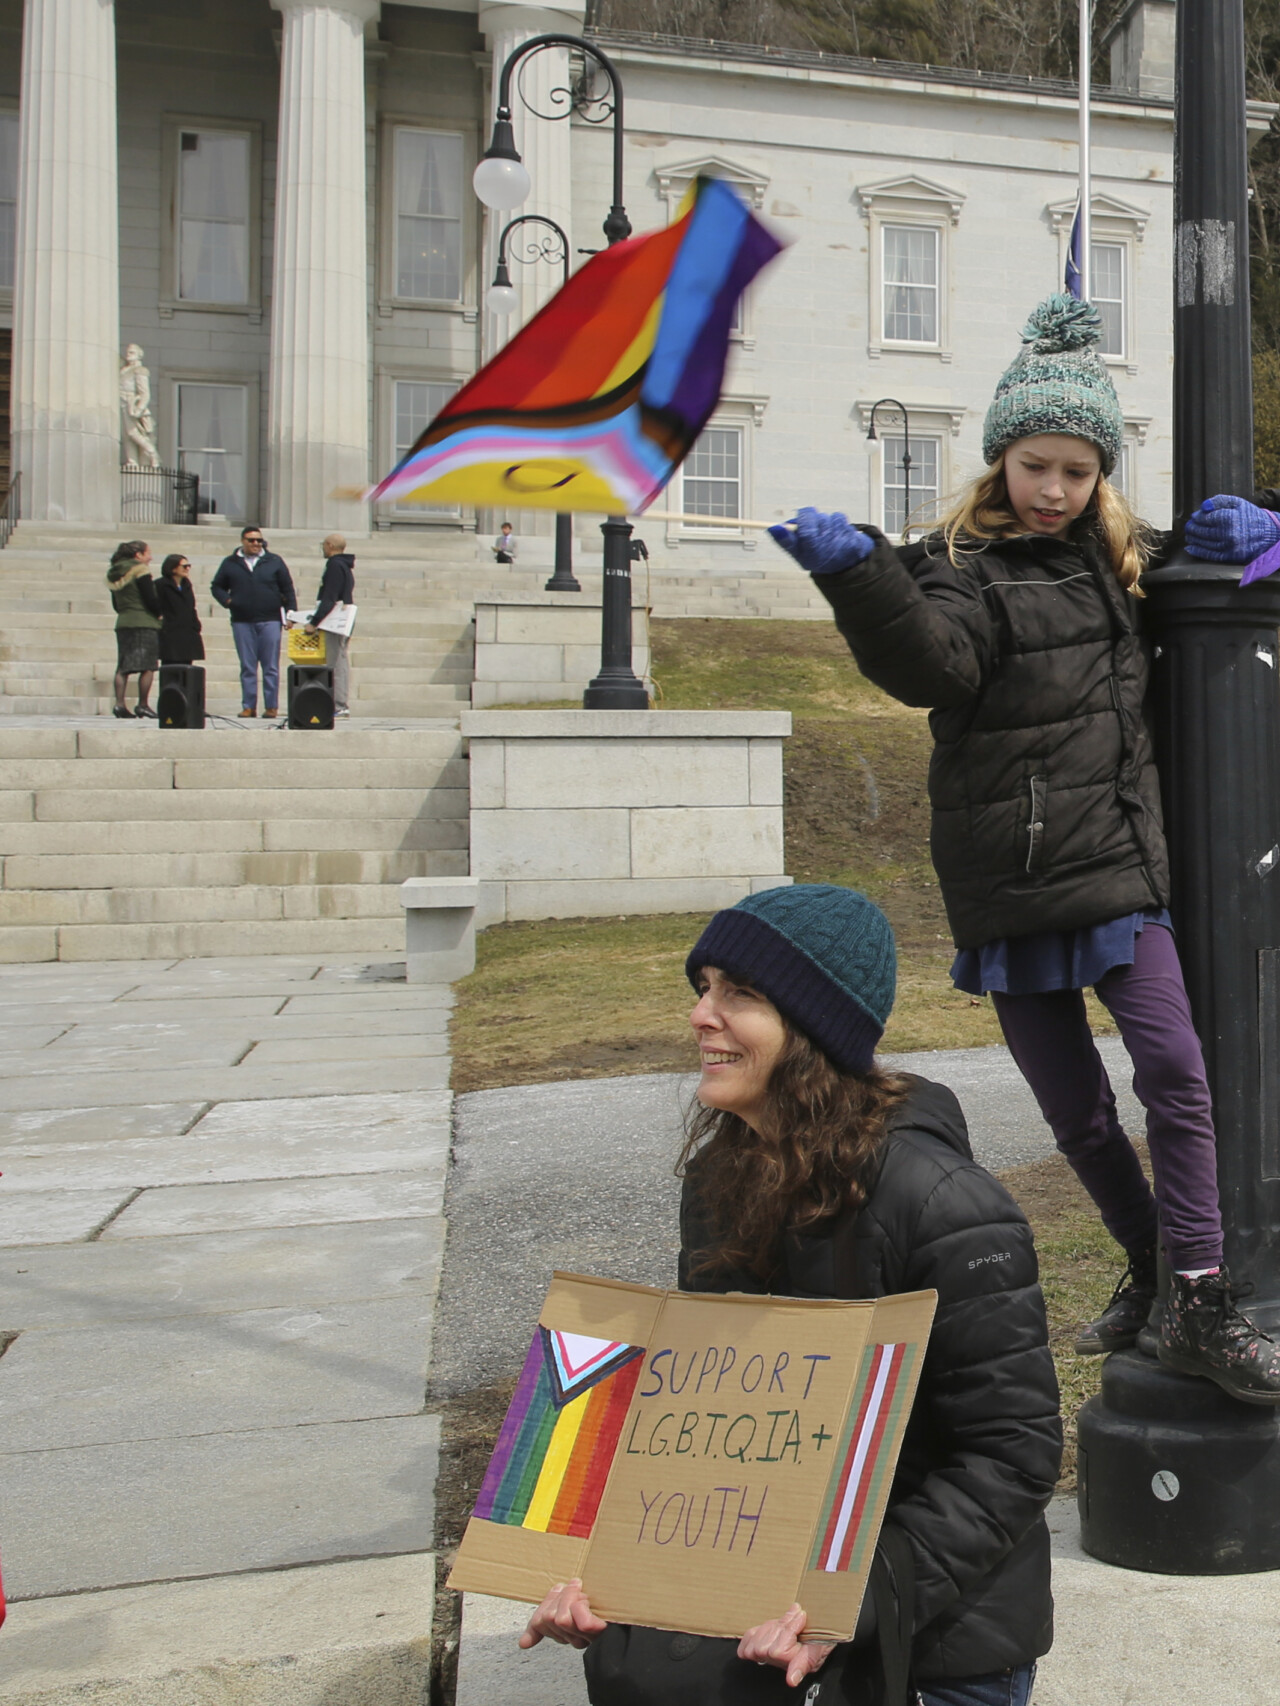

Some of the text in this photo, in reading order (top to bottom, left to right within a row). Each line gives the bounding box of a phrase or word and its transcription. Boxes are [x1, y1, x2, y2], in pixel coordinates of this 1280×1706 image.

[968, 1252, 1011, 1270] SPYDER
[640, 1346, 831, 1400] SUPPORT
[637, 1485, 768, 1556] YOUTH
